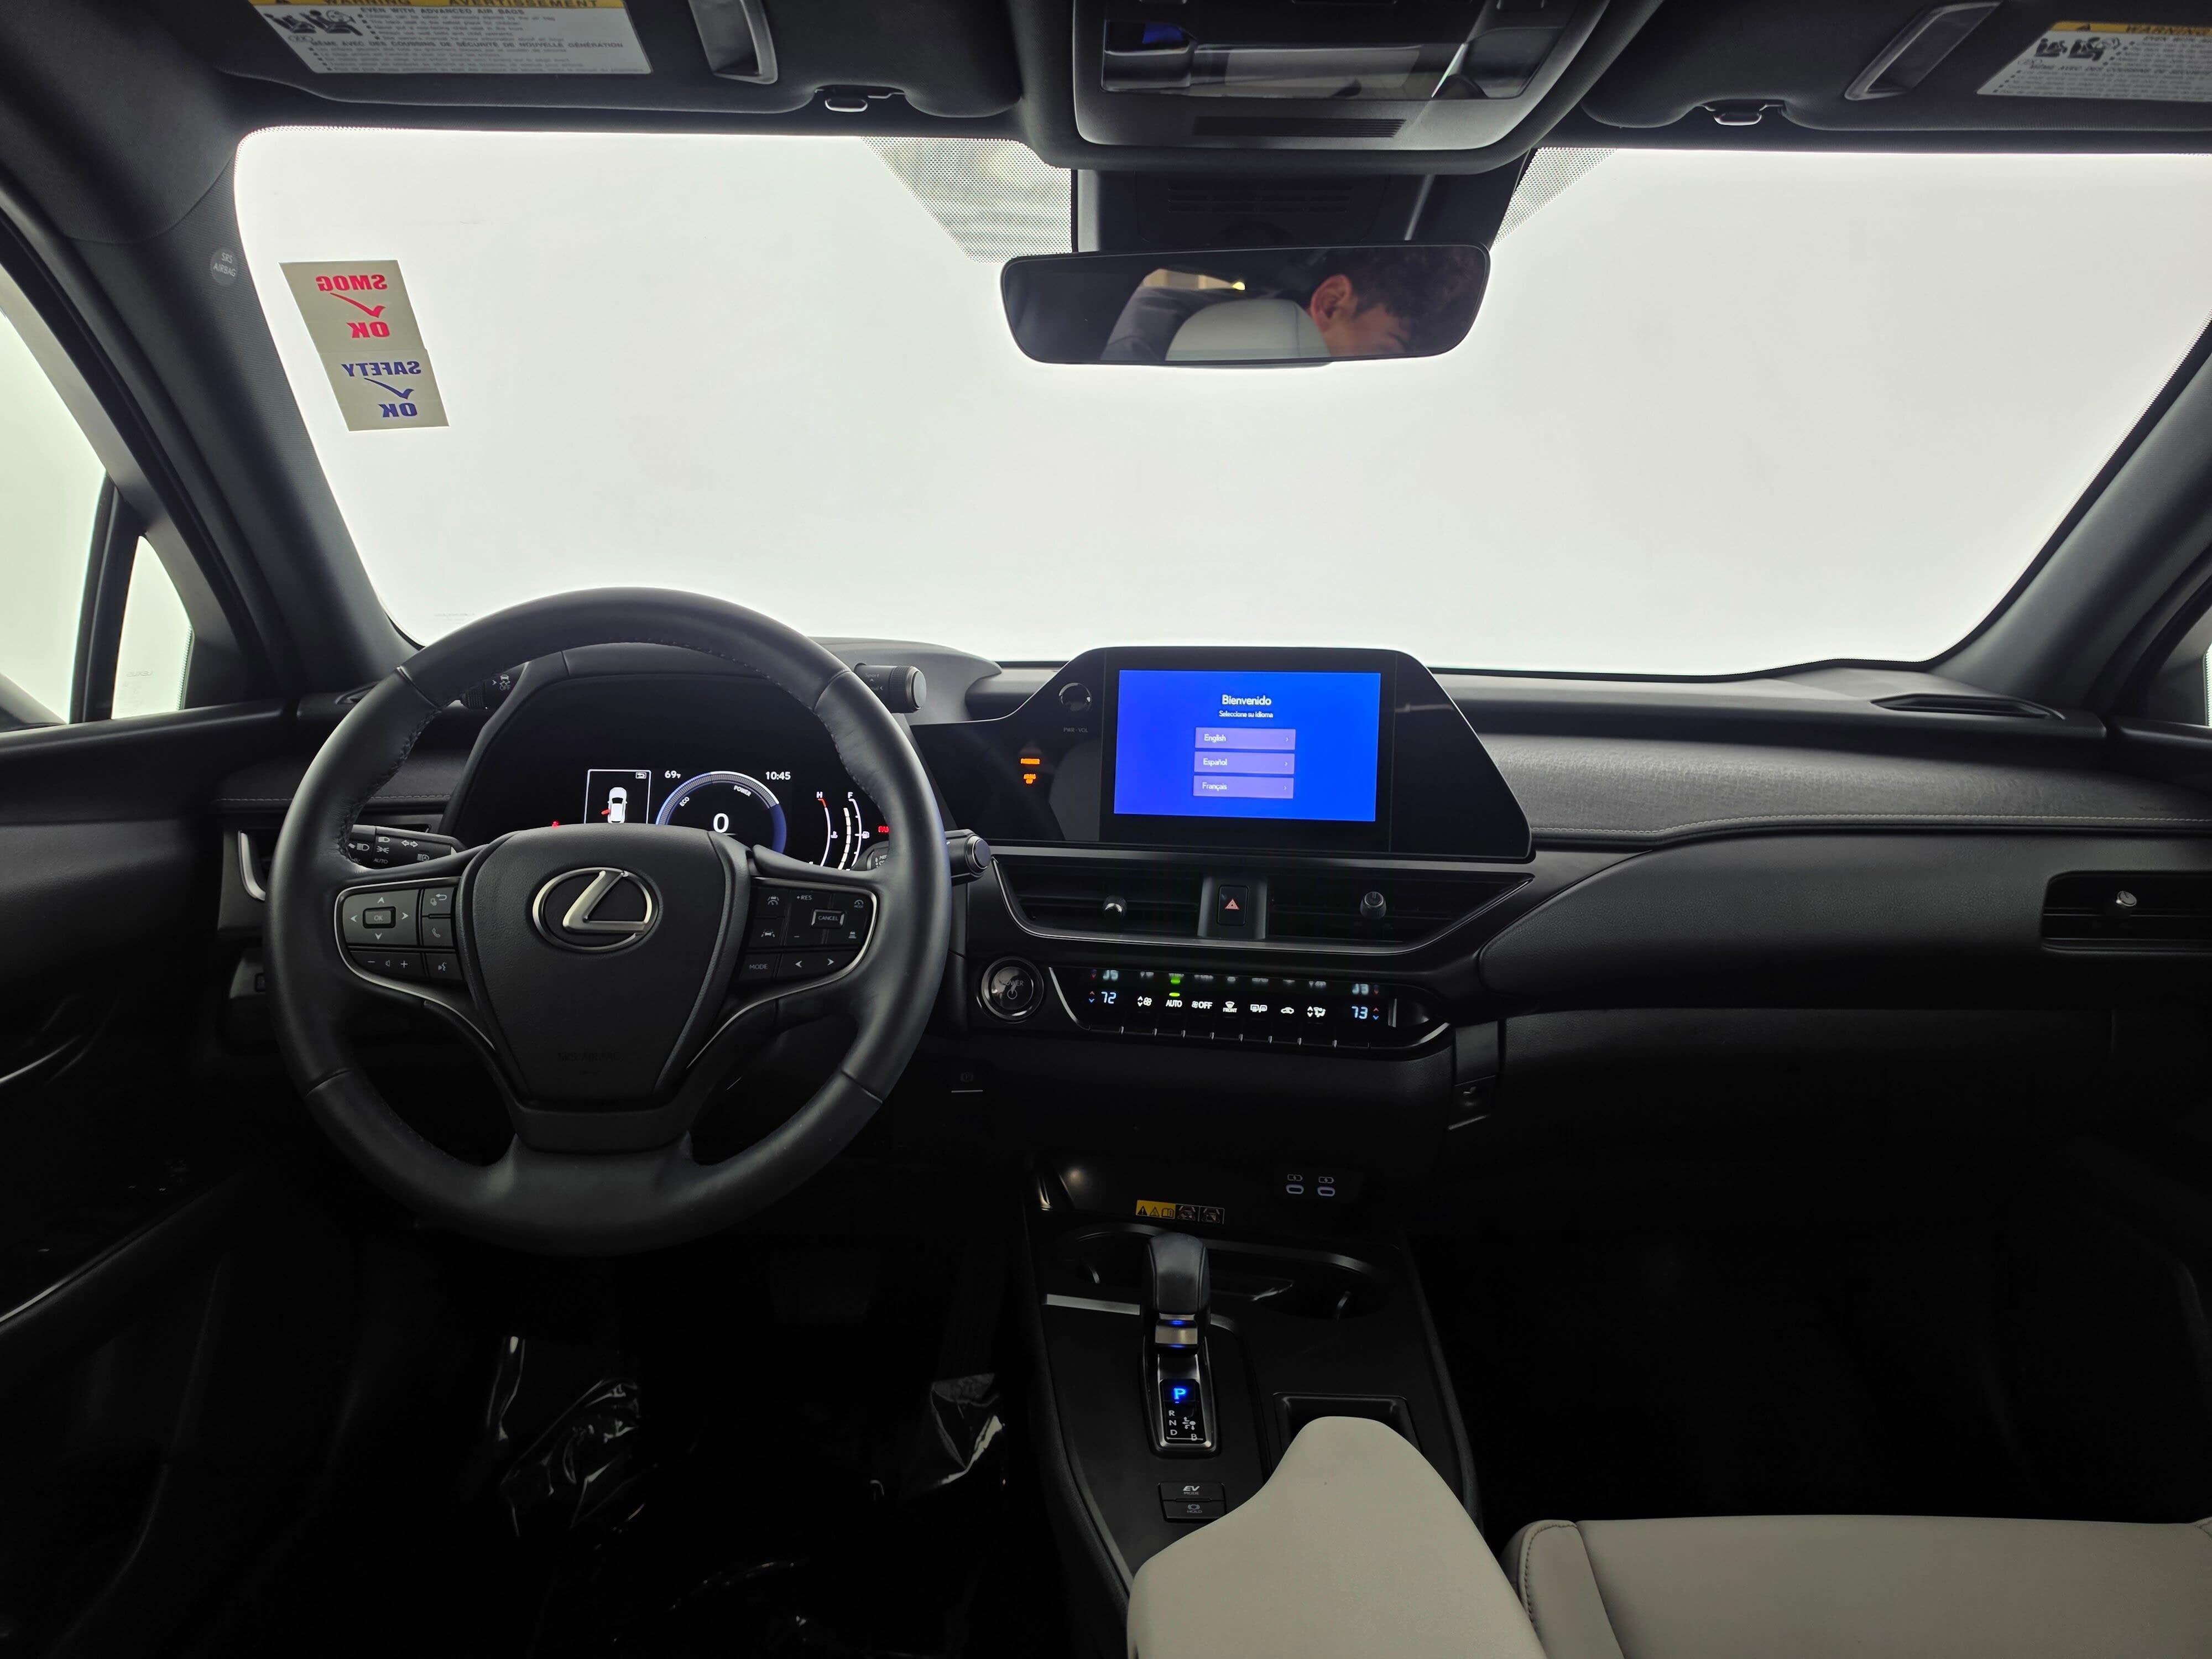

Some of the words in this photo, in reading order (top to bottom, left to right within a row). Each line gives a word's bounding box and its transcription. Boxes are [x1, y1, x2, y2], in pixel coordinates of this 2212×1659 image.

[221, 252, 233, 264] SRS
[213, 263, 237, 277] AIRBAG
[1222, 695, 1272, 706] Bienvenido
[1204, 733, 1227, 743] English
[1203, 758, 1228, 766] Español
[765, 771, 791, 780] 10:45
[733, 785, 752, 797] POWER
[1202, 781, 1228, 791] Français
[679, 796, 690, 807] ECO
[713, 813, 729, 833] 0
[1101, 992, 1117, 1004] 72
[1166, 999, 1182, 1008] AUTO
[1351, 1005, 1369, 1020] 73
[1173, 1387, 1186, 1400] P
